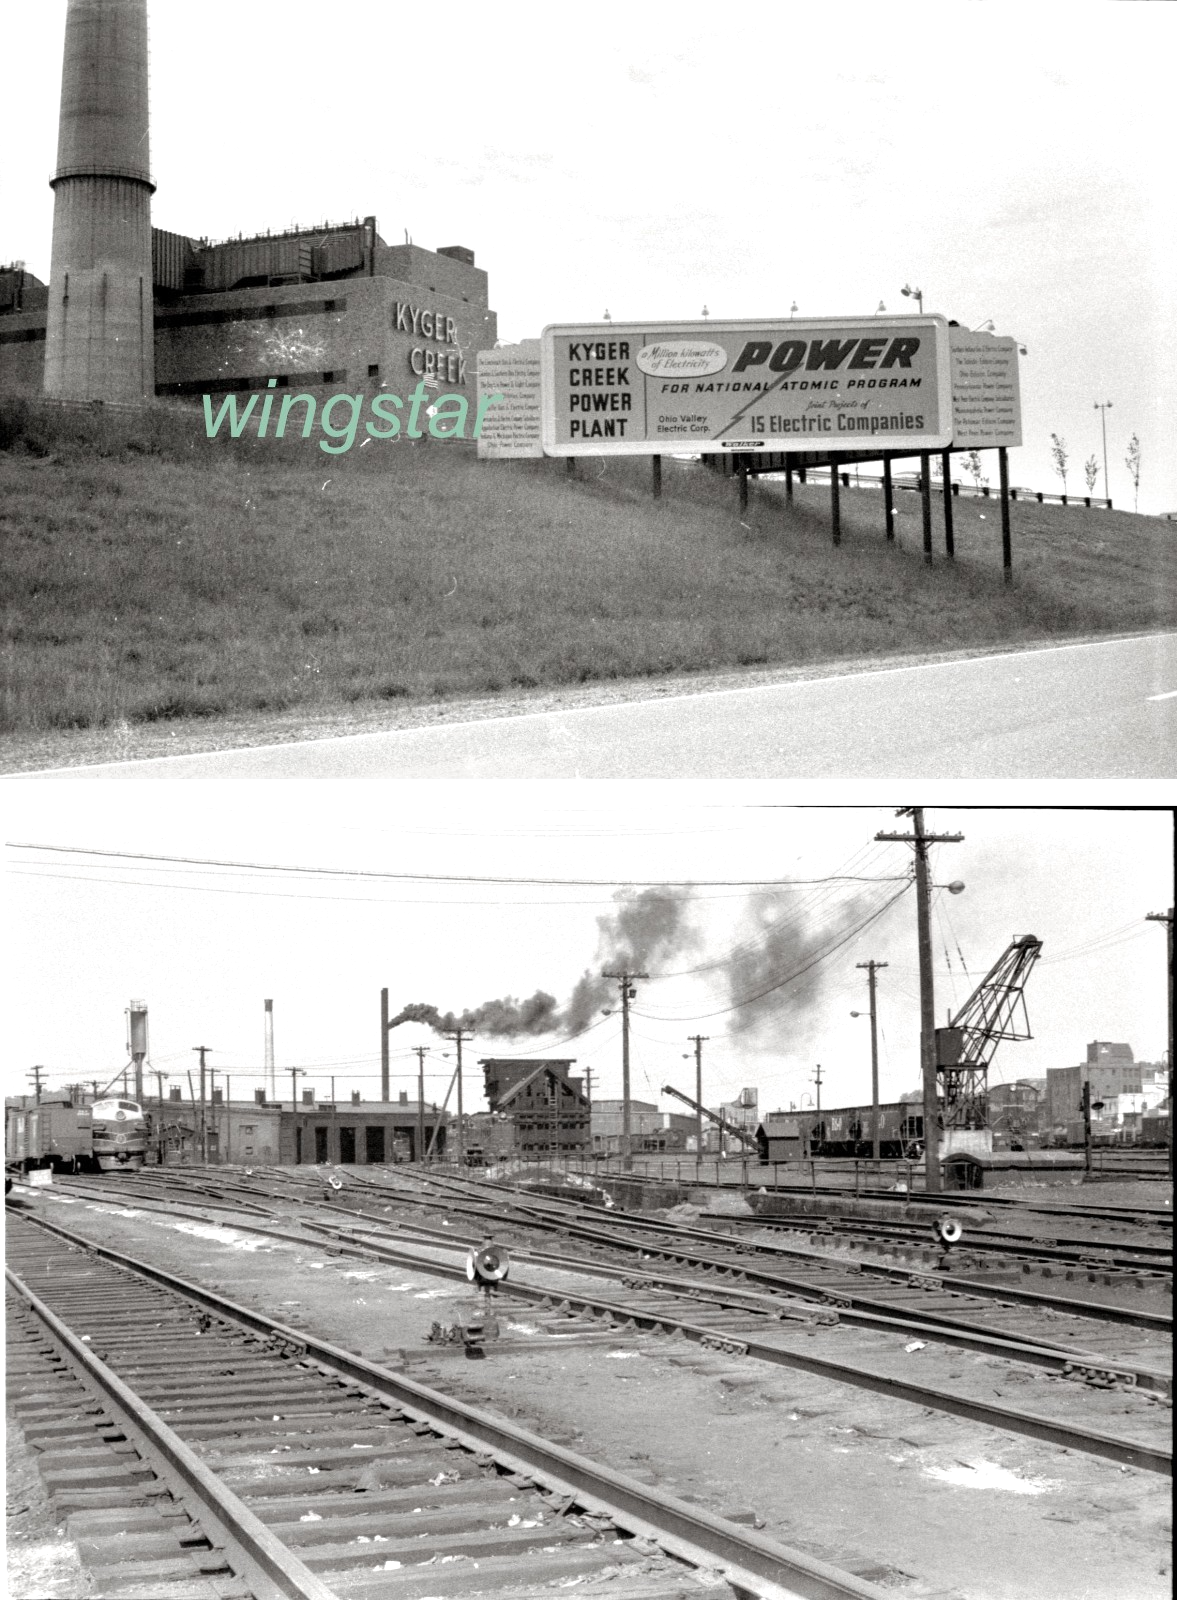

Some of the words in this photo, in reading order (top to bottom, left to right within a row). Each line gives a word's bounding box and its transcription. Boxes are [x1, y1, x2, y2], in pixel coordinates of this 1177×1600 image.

[395, 302, 457, 343] KYGER
[569, 342, 630, 361] KYGER
[647, 347, 678, 360] Million
[680, 348, 720, 358] kilowatts
[731, 337, 921, 372] POWER
[410, 347, 468, 385] CREEK
[651, 360, 662, 371] of
[663, 359, 711, 370] Electricity
[569, 367, 630, 386] CREEK
[661, 384, 689, 393] FOR
[695, 382, 771, 393] NATIONAL
[779, 380, 839, 391] ATOMIC
[847, 378, 922, 389] PROGRAM
[570, 393, 631, 412] POWER
[805, 400, 827, 411] Joint
[828, 400, 858, 410] Projects
[860, 400, 870, 409] of
[570, 418, 628, 438] PLANT
[657, 425, 688, 433] Electric
[690, 424, 711, 433] Corp.
[658, 415, 678, 423] Ohio
[680, 414, 708, 424] Valley
[751, 415, 765, 433] 15
[769, 414, 832, 433] Electric
[837, 412, 924, 435] Companies
